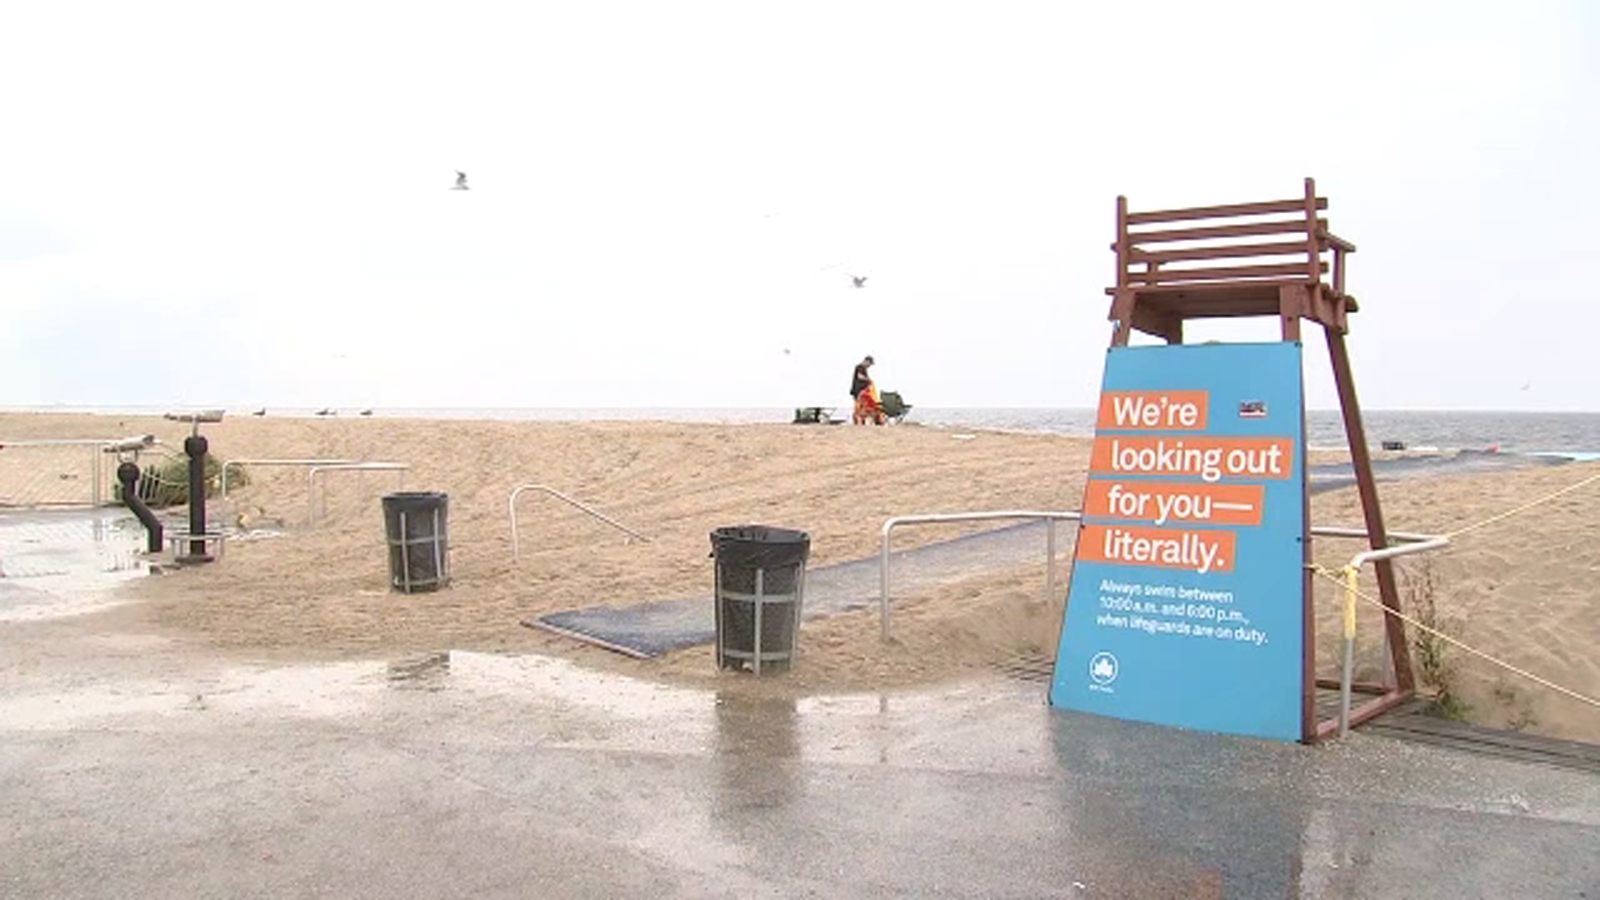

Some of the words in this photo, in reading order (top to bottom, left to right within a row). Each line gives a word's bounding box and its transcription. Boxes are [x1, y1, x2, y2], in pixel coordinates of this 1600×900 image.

[1113, 396, 1198, 426] We're
[1112, 440, 1223, 481] looking
[1227, 444, 1282, 474] out
[1108, 485, 1150, 515] for
[1104, 529, 1224, 573] literally.
[1099, 579, 1142, 597] Always
[1144, 584, 1175, 598] swim
[1178, 586, 1233, 603] between
[1100, 596, 1133, 611] 10:00
[1161, 603, 1185, 616] and
[1187, 604, 1215, 618] 6:00
[1097, 613, 1128, 628] when
[1130, 615, 1190, 635] lifeguards
[1192, 625, 1213, 637] are
[1215, 626, 1233, 639] on
[1234, 627, 1269, 646] duty.
